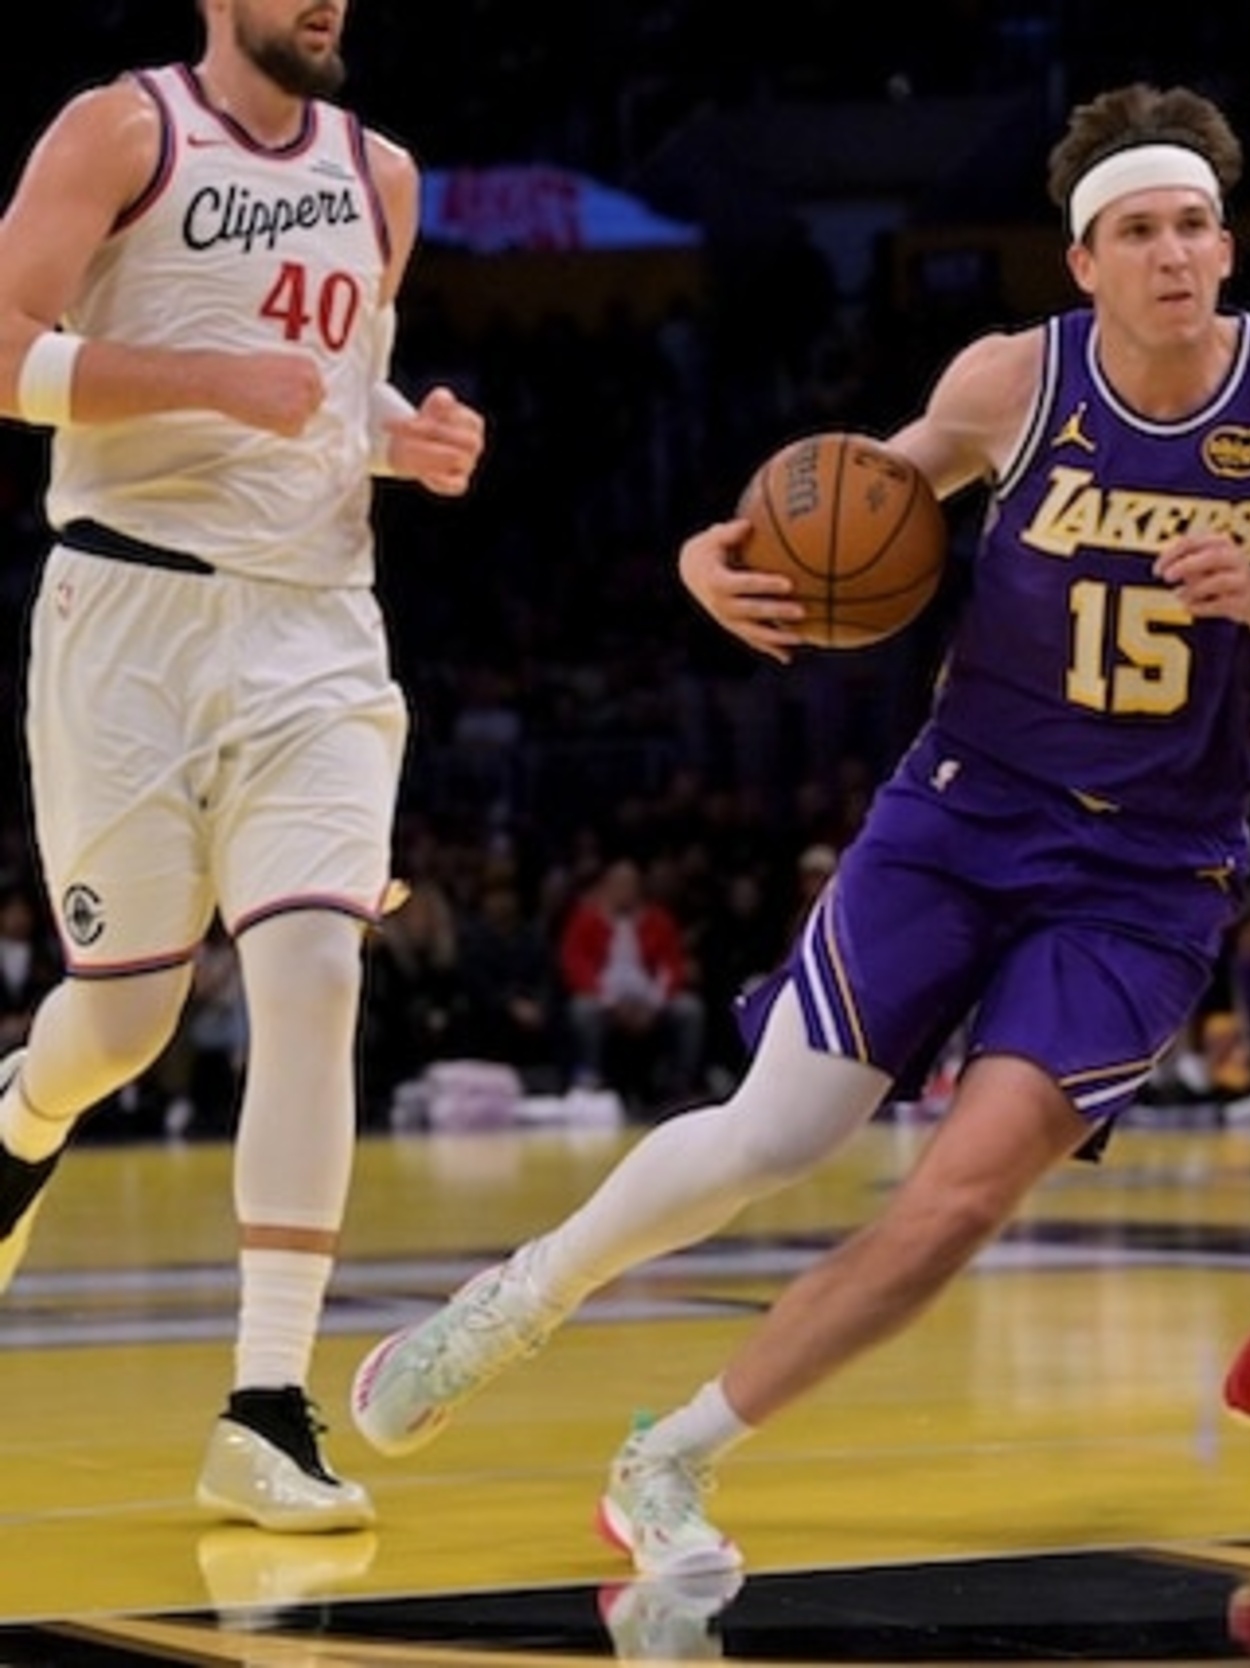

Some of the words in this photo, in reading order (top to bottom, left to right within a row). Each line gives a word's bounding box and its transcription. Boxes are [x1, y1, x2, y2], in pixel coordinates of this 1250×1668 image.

[182, 184, 360, 254] Clippers
[258, 261, 360, 354] 40
[1064, 578, 1194, 715] 15
